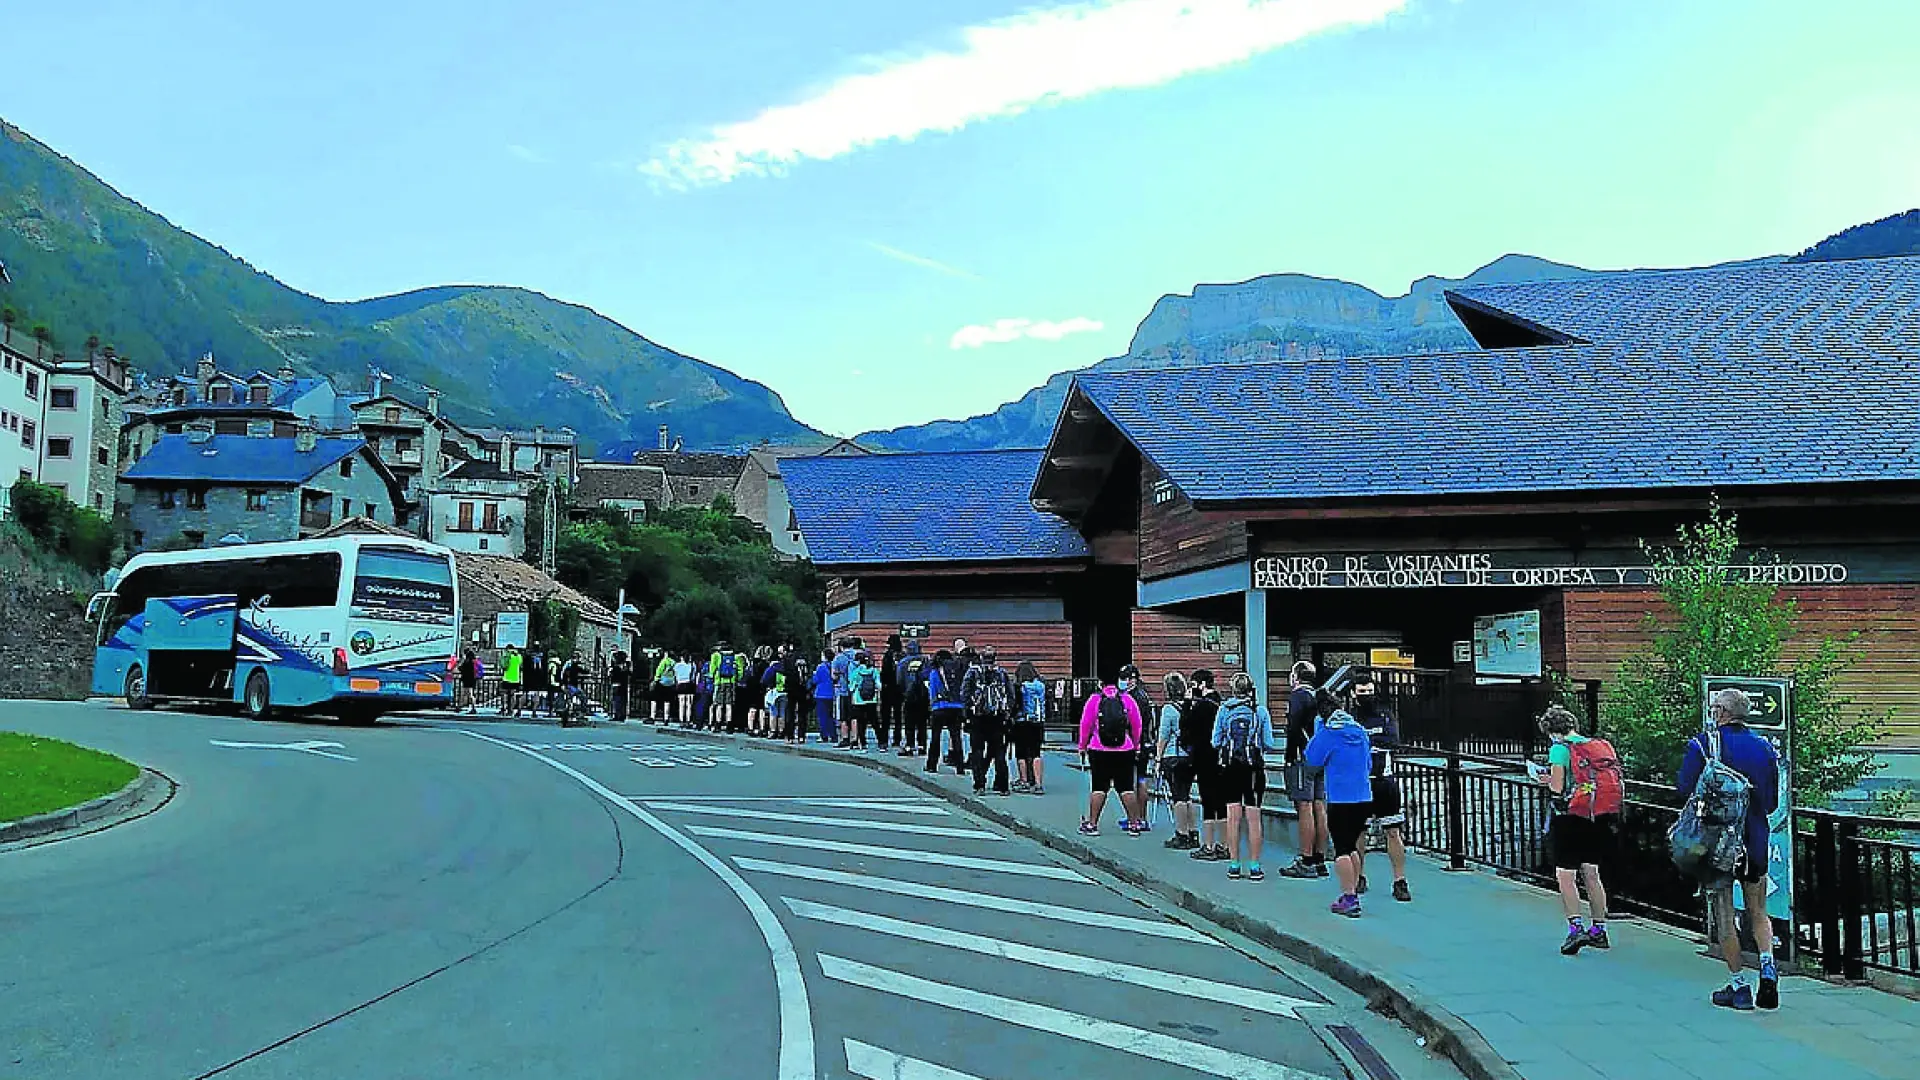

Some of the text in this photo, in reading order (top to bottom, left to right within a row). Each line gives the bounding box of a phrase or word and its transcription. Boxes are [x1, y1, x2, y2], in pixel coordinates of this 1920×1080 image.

[1254, 554, 1492, 573] CENTRO DE VISITANTES
[1254, 571, 1330, 589] PARQUE
[1345, 571, 1442, 588] NACIONAL
[1467, 570, 1492, 587] DE
[1512, 569, 1596, 585] ORDESA
[1615, 568, 1627, 584] Y
[1749, 564, 1848, 583] PERDIDO
